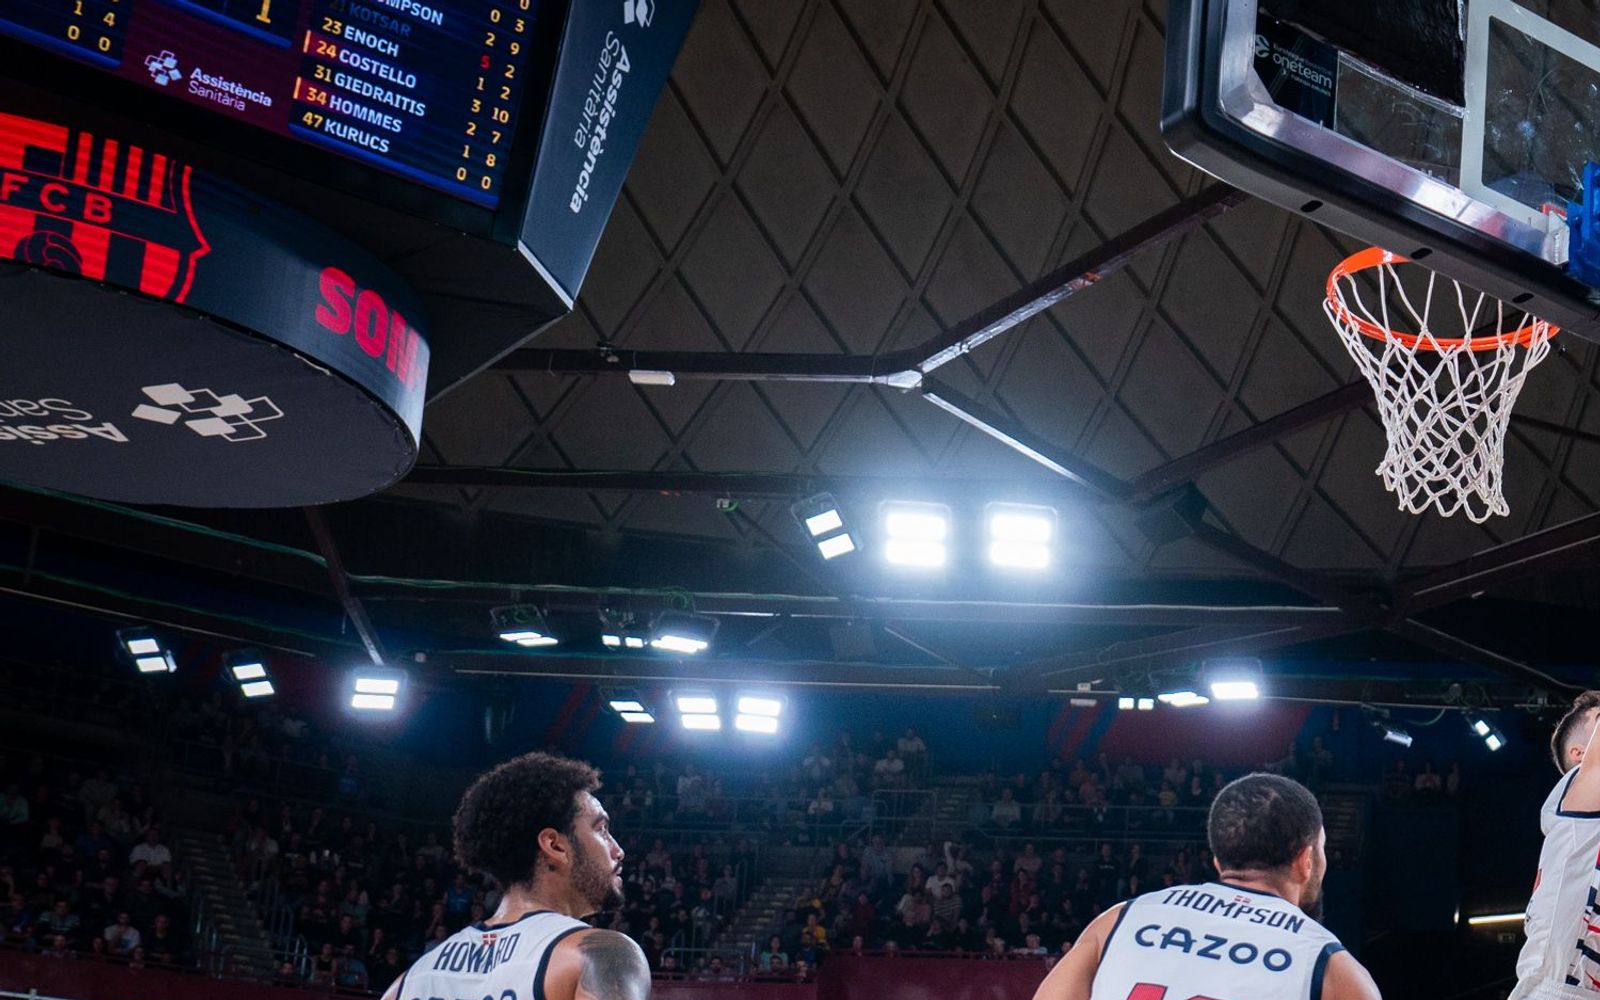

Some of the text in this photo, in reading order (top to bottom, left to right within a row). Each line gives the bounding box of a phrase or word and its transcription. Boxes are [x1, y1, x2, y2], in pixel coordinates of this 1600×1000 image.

[67, 25, 111, 52] 0 0
[103, 12, 116, 27] 4
[514, 19, 524, 33] 3
[322, 17, 510, 100] 23 ENOCH 1 2
[485, 32, 495, 46] 2
[510, 42, 520, 56] 9
[189, 67, 272, 107] Assistència
[316, 40, 509, 124] 24 COSTELLO 3 10
[505, 64, 515, 79] 2
[574, 31, 620, 149] Sanitària
[1273, 53, 1333, 89] oneteam
[187, 81, 246, 112] Sanitària
[314, 65, 501, 144] 31 GIEDRAITIS 2 7
[306, 87, 496, 168] 34 HOMMES 1 8
[569, 45, 631, 214] Assistència
[302, 112, 491, 190] 47 KURUCS 0 0
[1162, 888, 1305, 934] THOMPSON
[433, 932, 521, 975] HOWARD
[1135, 924, 1292, 972] CAZOO
